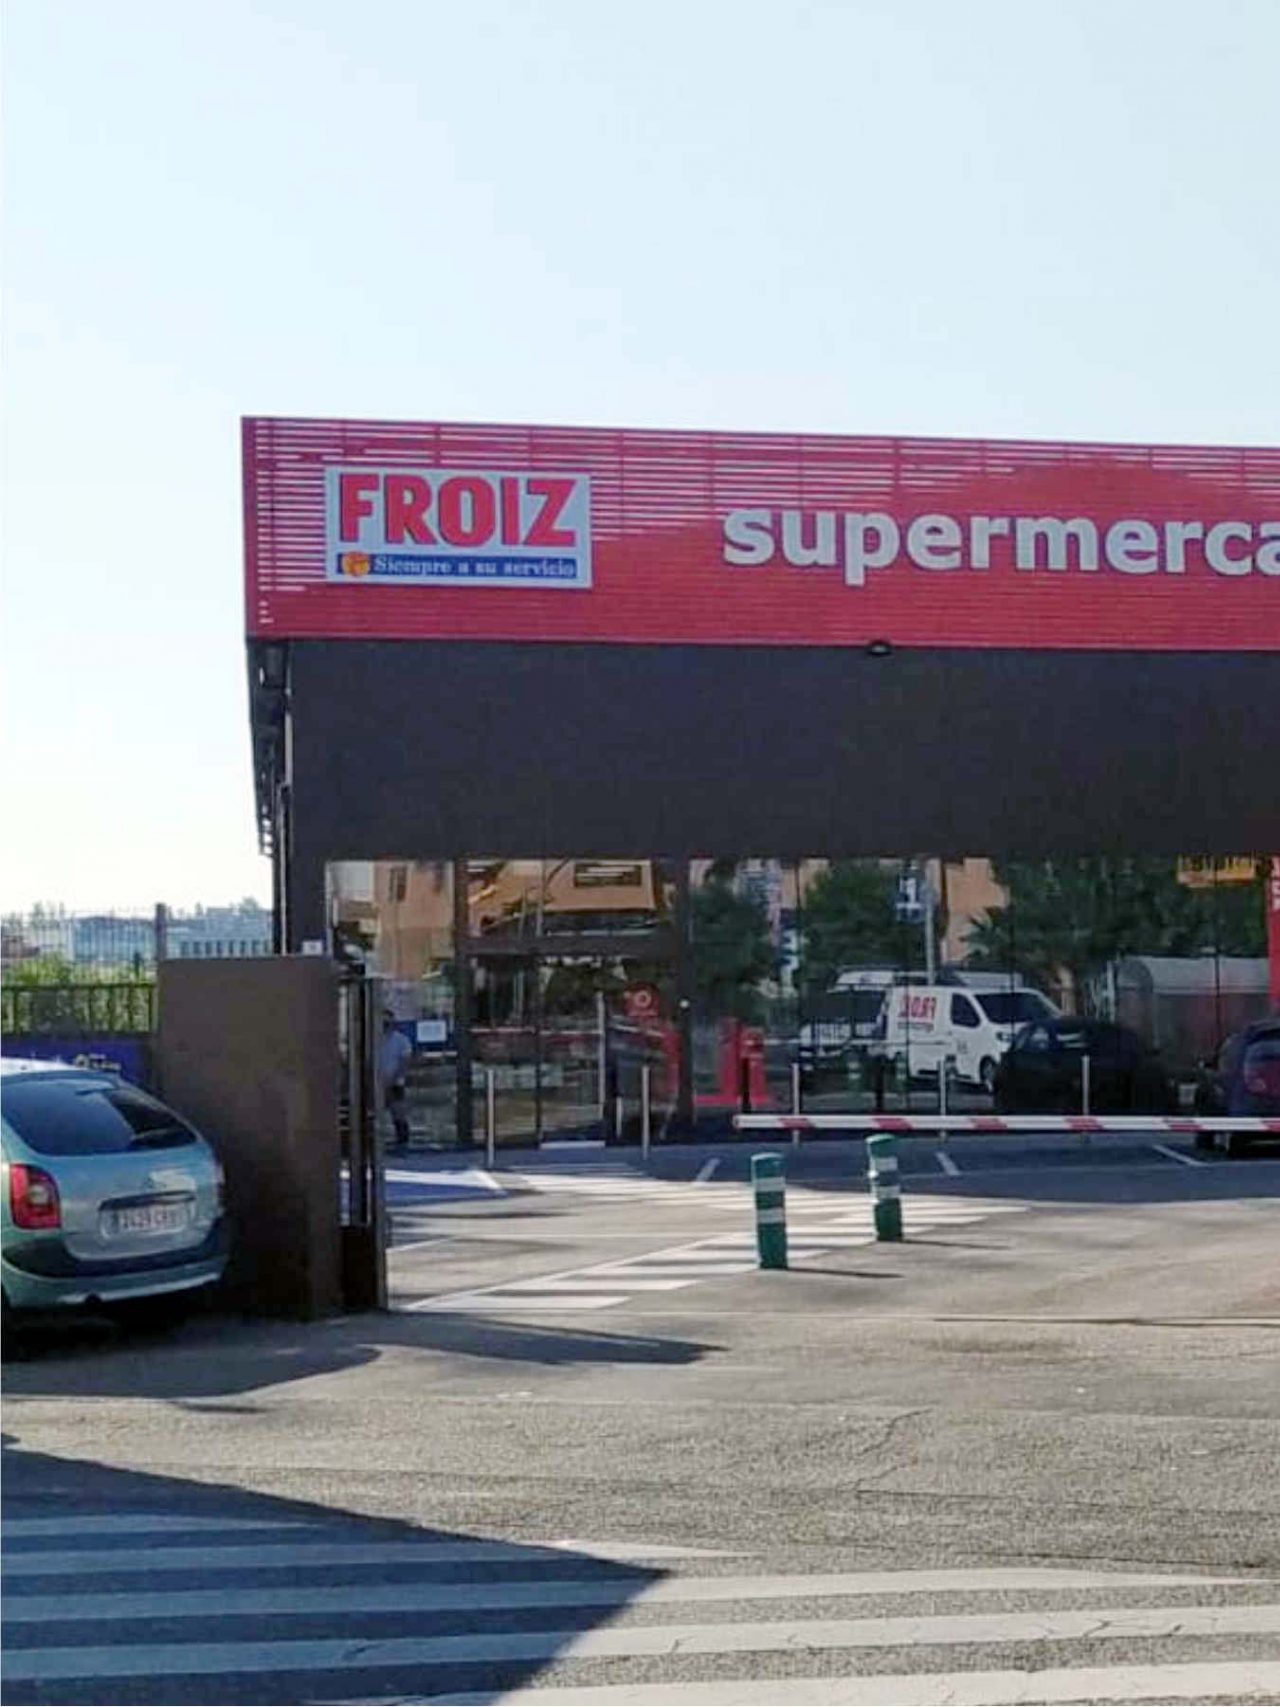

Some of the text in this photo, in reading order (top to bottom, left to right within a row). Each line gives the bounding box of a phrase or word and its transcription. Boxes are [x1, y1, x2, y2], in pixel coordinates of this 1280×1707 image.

[339, 472, 577, 547] FROIZ
[373, 555, 453, 577] Siempre
[474, 563, 497, 575] su
[503, 558, 576, 578] servicio
